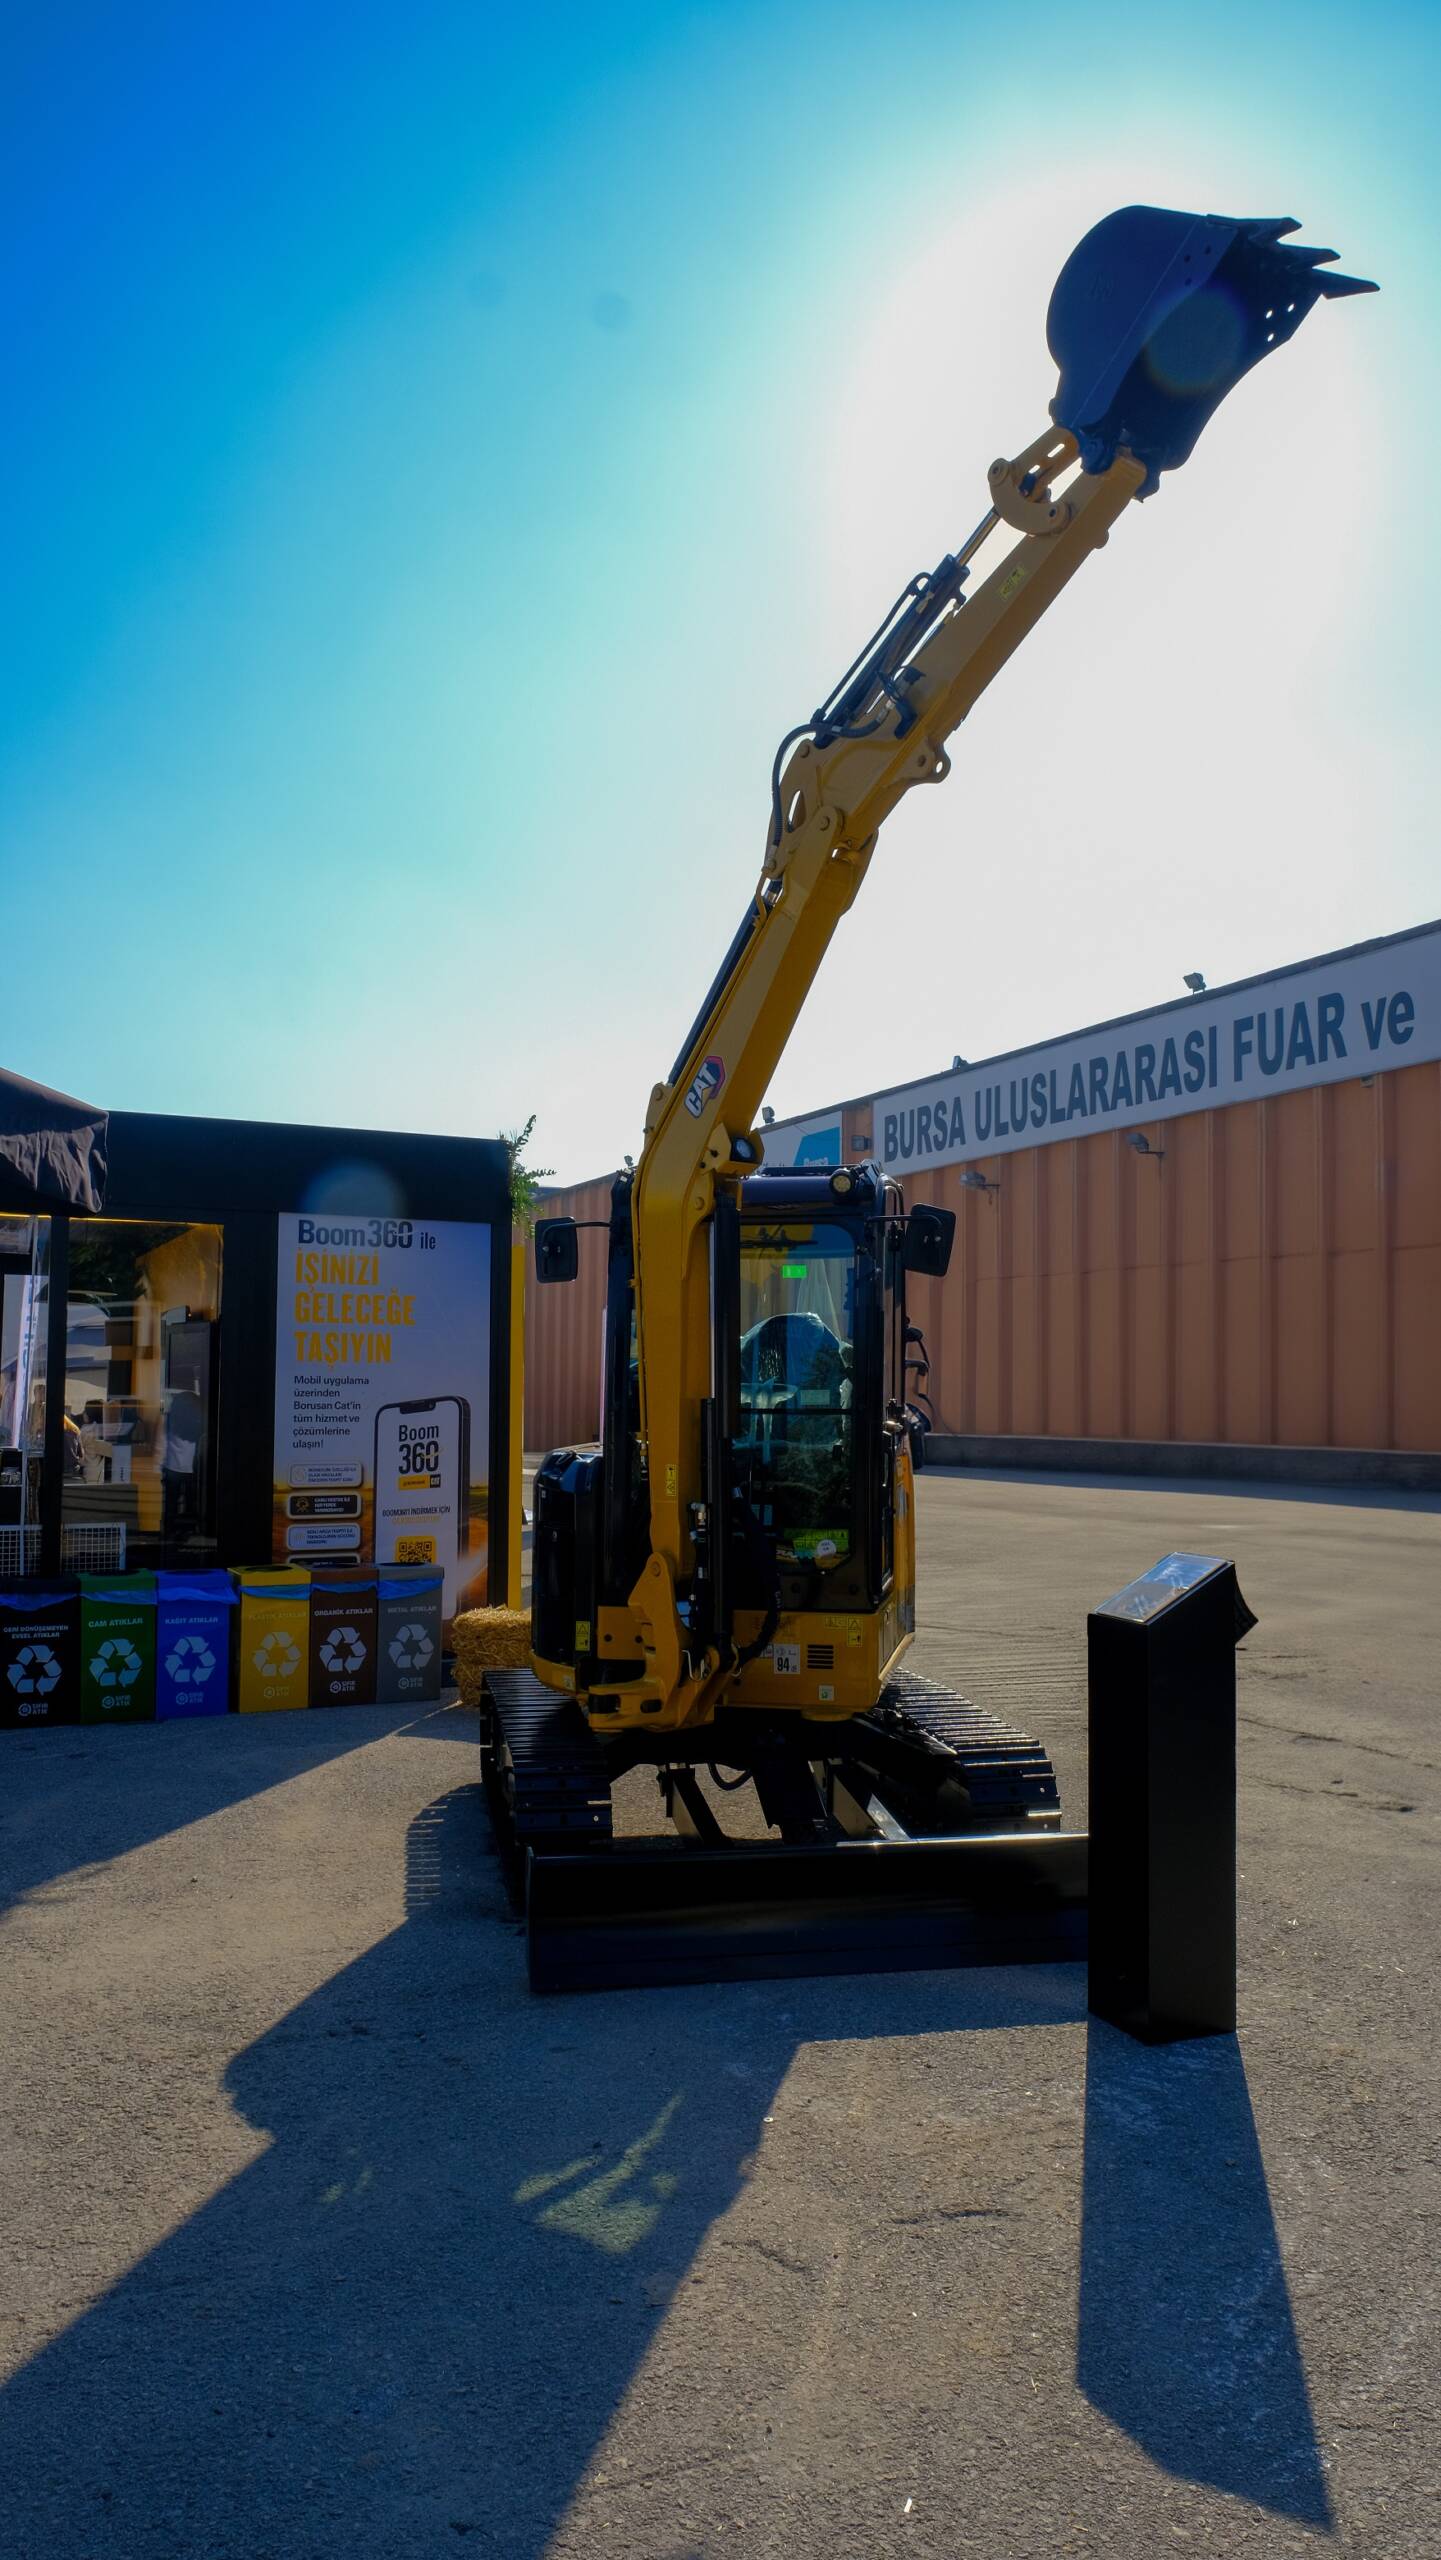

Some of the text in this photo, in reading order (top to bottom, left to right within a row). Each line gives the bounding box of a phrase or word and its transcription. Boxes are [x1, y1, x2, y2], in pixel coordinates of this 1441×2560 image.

[884, 991, 1415, 1163] BURSA ULUSLARARASI FUAR ve
[683, 1061, 719, 1119] CAT
[298, 1219, 436, 1250] Boom360 ile
[294, 1288, 417, 1326] GELECEĞE
[294, 1331, 392, 1368] TAŞIYIN
[294, 1375, 370, 1387] Mobil uygulama
[293, 1388, 341, 1397] üzerinden
[293, 1400, 333, 1410] Borusan
[293, 1413, 360, 1423] tüm hizmet ve
[292, 1426, 351, 1437] çözümlerine
[398, 1424, 440, 1442] Boom
[292, 1439, 324, 1451] ulaşın!
[398, 1440, 440, 1475] 360
[345, 1607, 374, 1615] ATIKLAR
[88, 1617, 144, 1628] CAM ATIKLAR
[777, 1657, 789, 1672] 94
